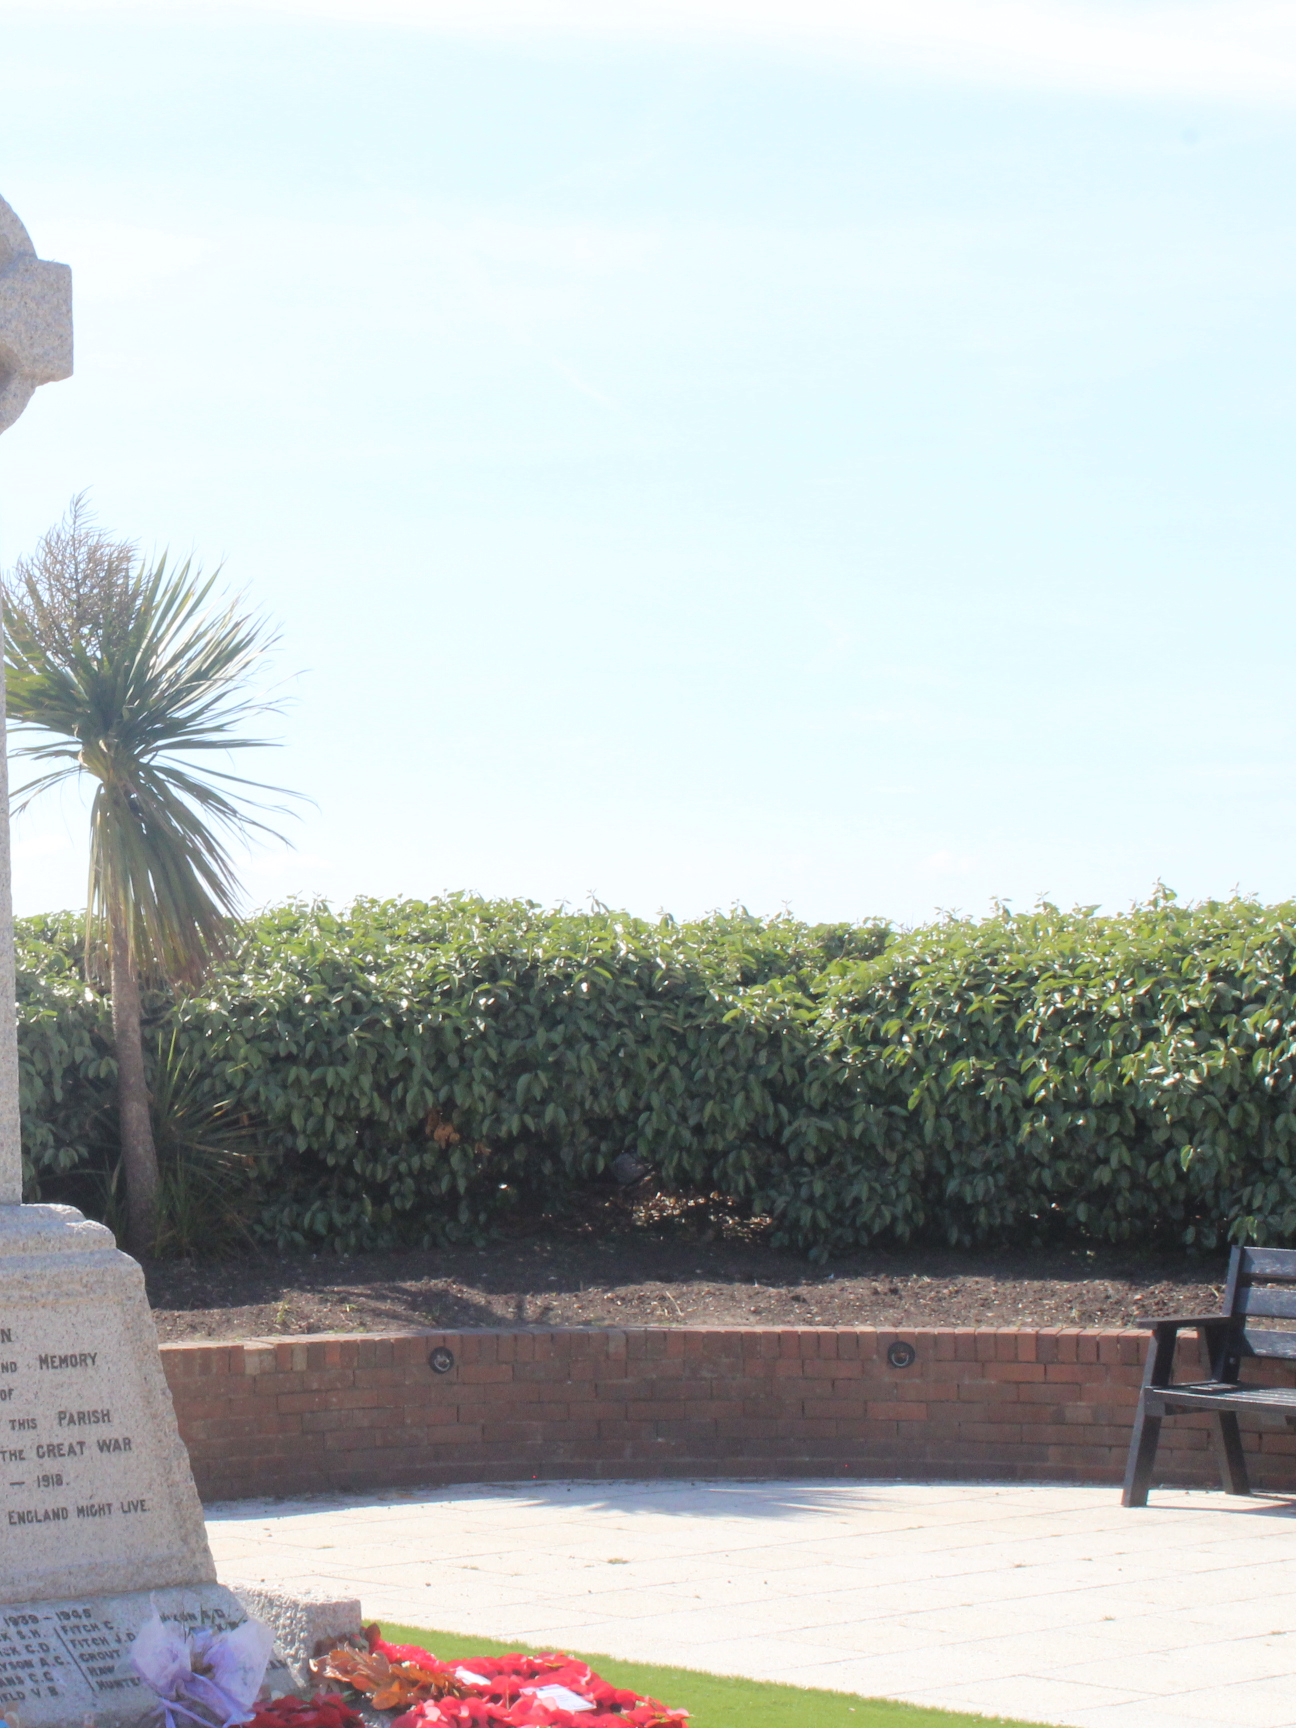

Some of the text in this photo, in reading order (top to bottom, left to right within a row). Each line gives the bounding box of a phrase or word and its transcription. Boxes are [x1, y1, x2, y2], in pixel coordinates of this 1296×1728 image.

[39, 1352, 98, 1371] MEMORY
[0, 1388, 14, 1401] OF
[9, 1418, 38, 1432] THIS
[57, 1409, 111, 1427] PARISH
[0, 1449, 26, 1462] THE
[36, 1441, 86, 1459] GREAT
[97, 1437, 132, 1454] WAR
[8, 1507, 68, 1526] ENGLAND
[77, 1502, 113, 1518] MIGHT
[3, 1614, 39, 1627] 1939
[55, 1608, 92, 1621] 1945
[61, 1622, 101, 1636] FITCH
[70, 1636, 110, 1649] FITCH
